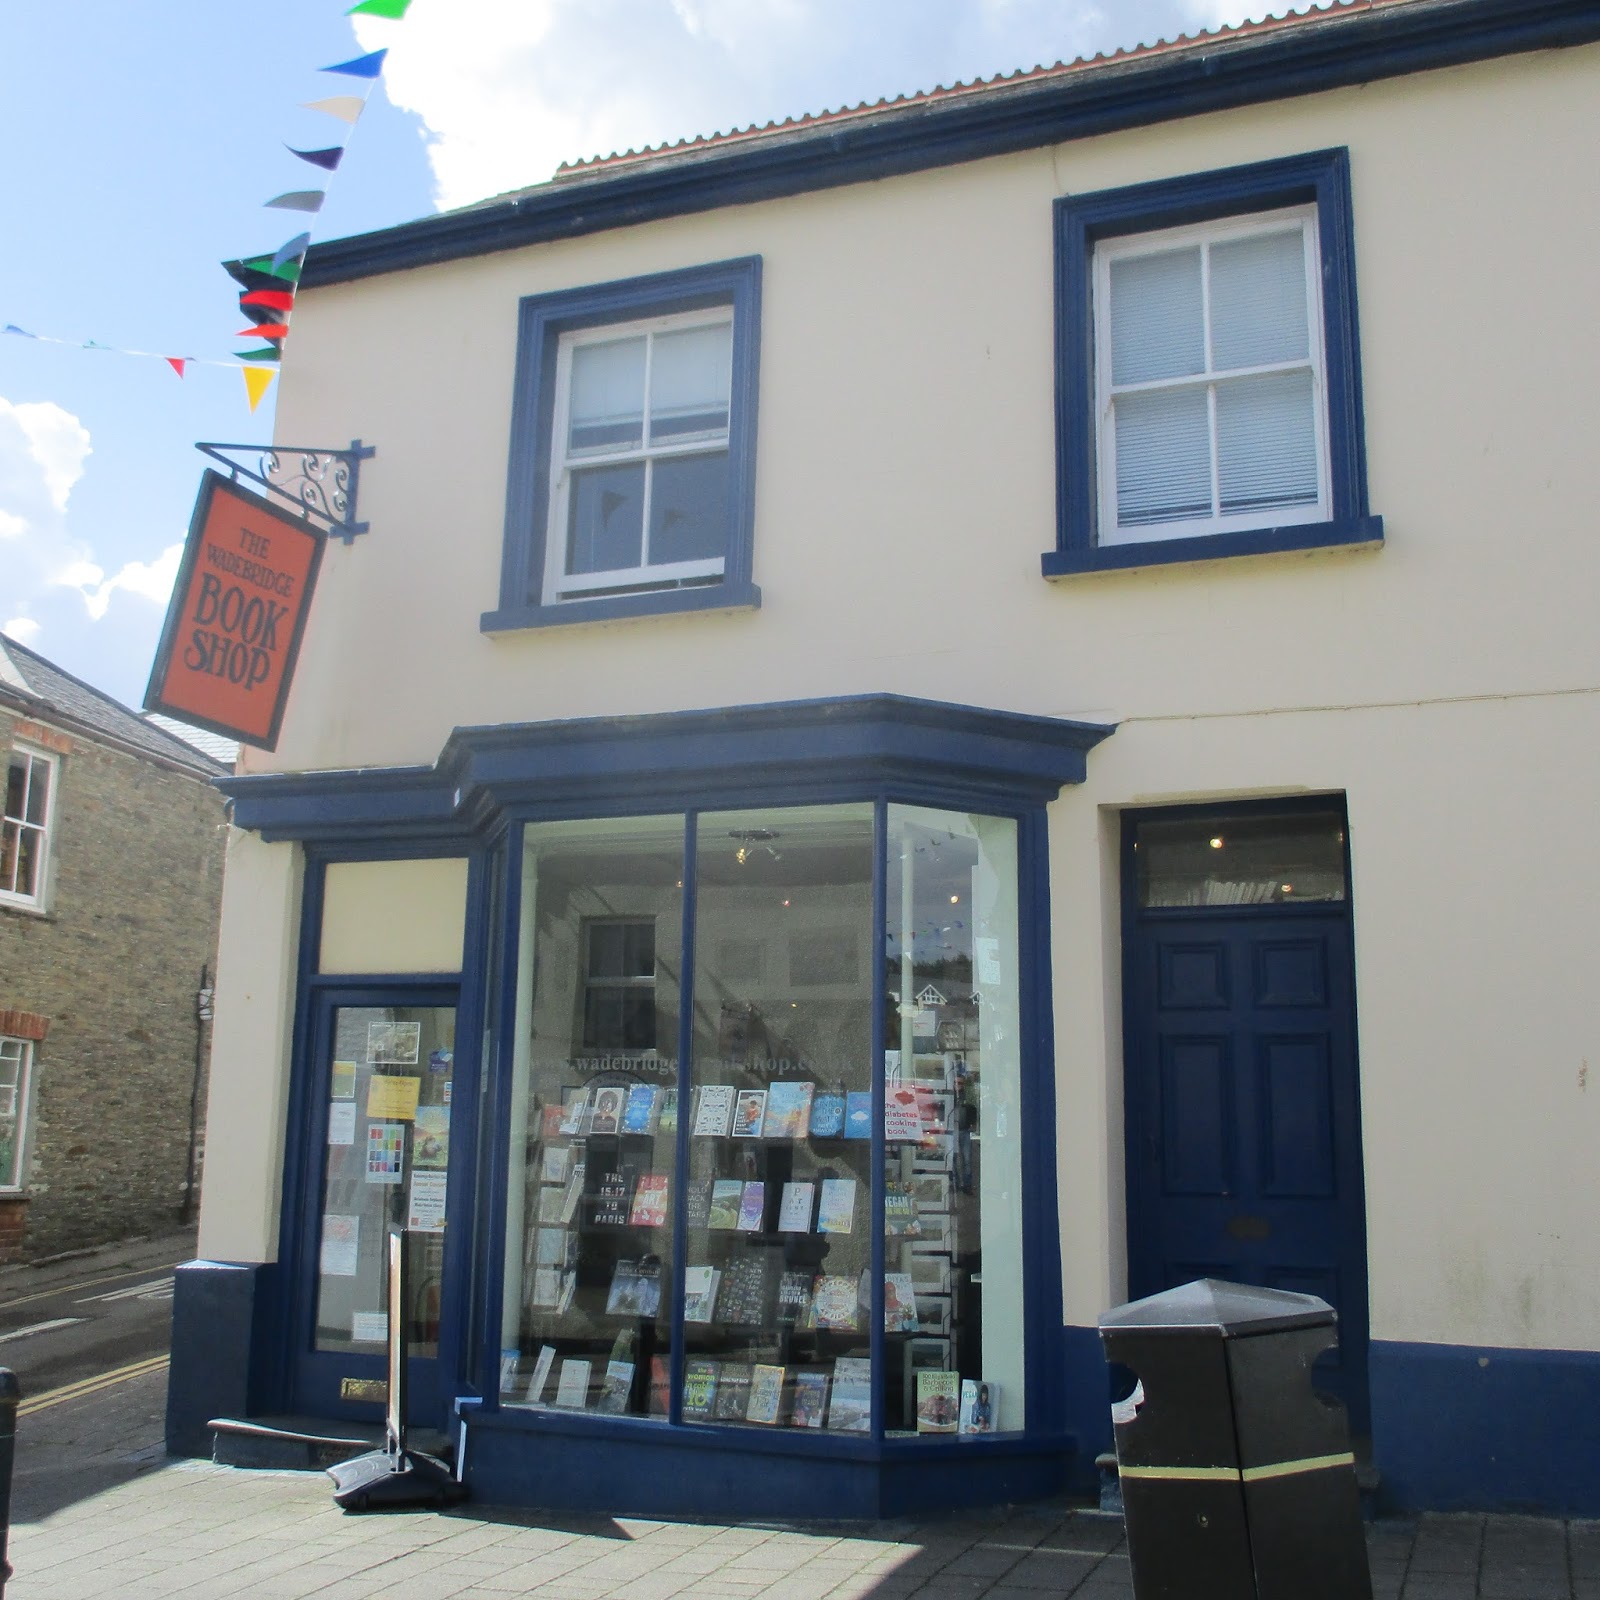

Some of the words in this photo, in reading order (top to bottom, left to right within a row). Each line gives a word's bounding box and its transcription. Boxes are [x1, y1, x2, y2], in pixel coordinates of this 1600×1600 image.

[240, 527, 271, 560] THE
[207, 543, 294, 597] WADEBRIDGE
[192, 572, 289, 651] BOOK
[183, 628, 271, 691] SHOP
[887, 1120, 917, 1128] cooking
[605, 1172, 624, 1183] THE
[600, 1187, 625, 1197] 15:17
[606, 1201, 618, 1211] TO
[594, 1214, 625, 1224] PARIS
[687, 1393, 707, 1406] 10
